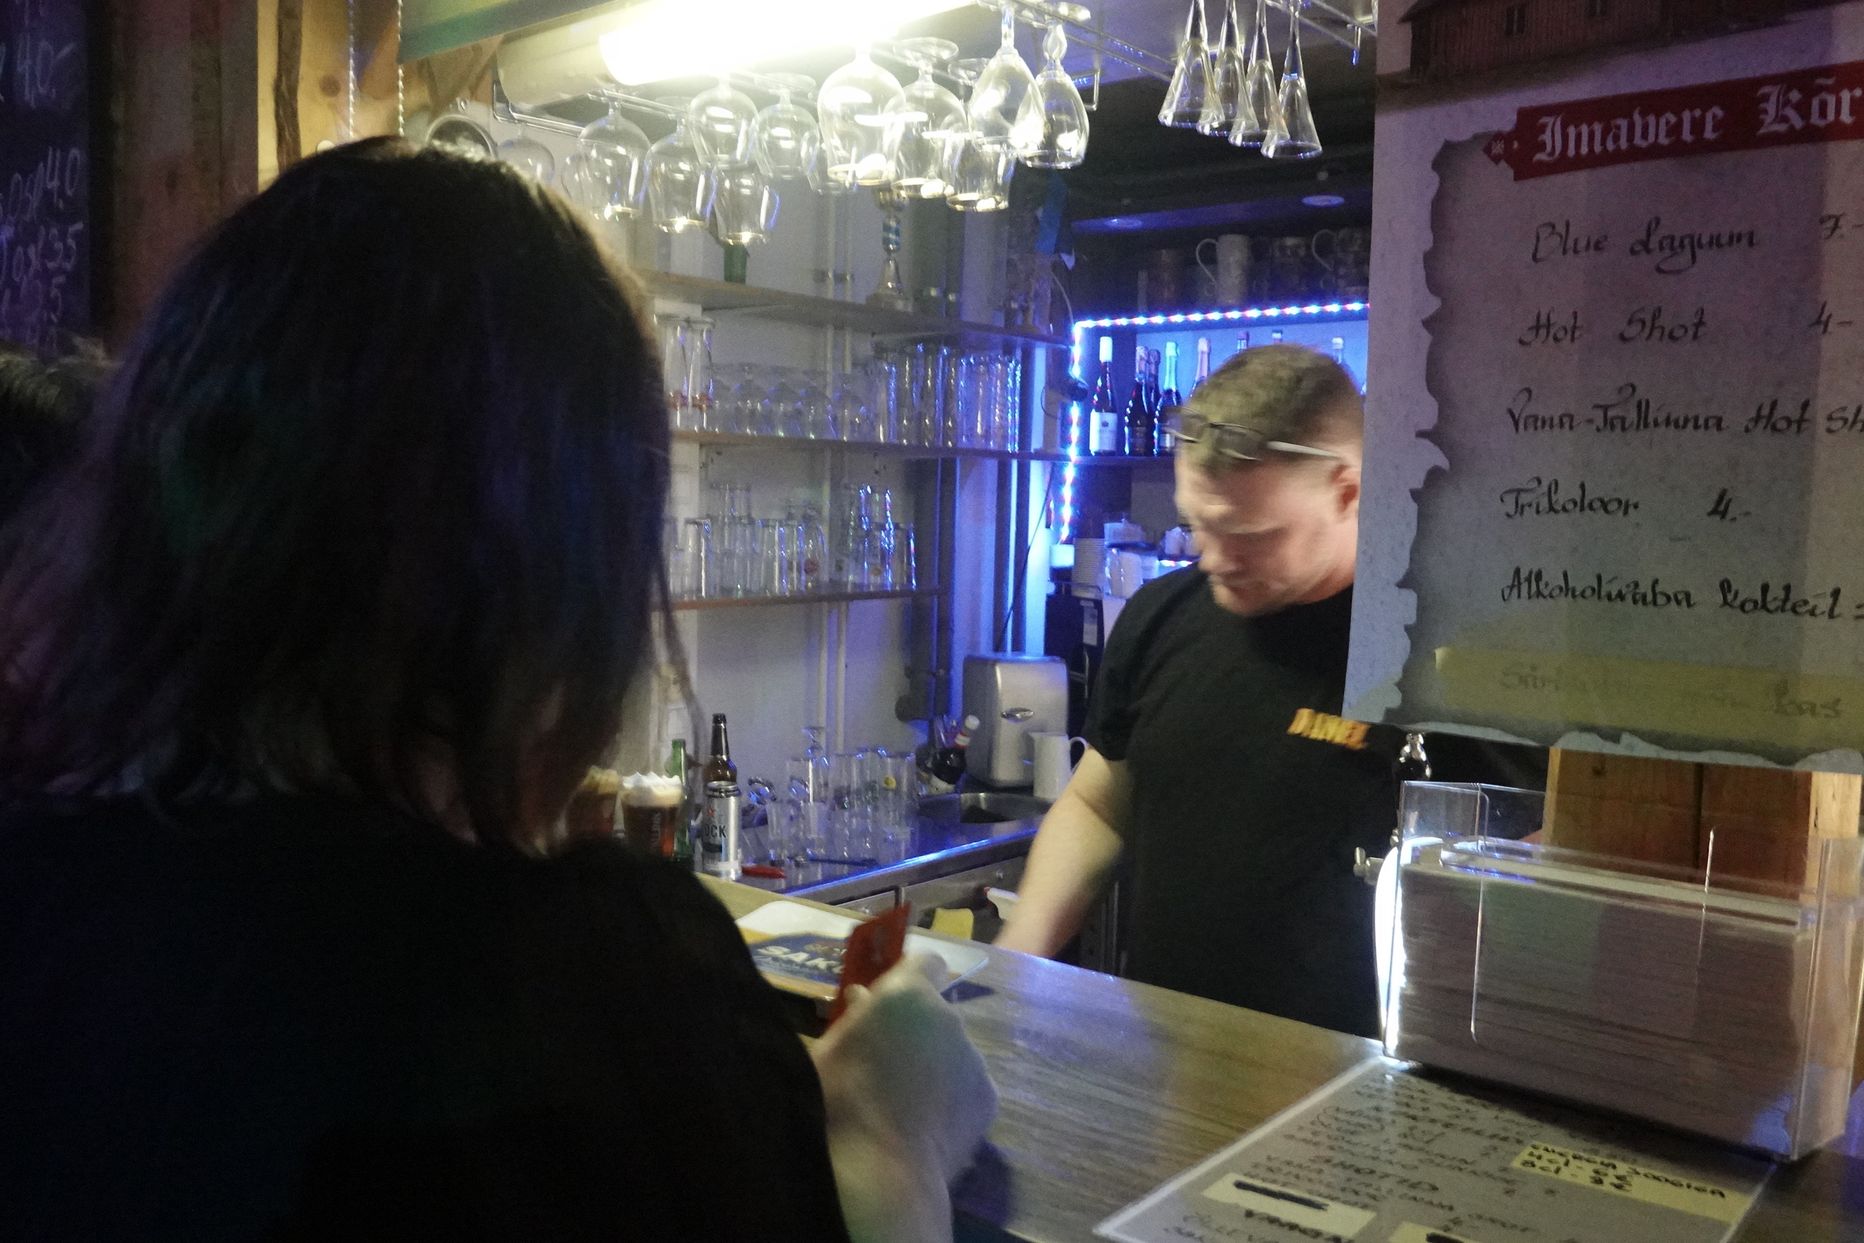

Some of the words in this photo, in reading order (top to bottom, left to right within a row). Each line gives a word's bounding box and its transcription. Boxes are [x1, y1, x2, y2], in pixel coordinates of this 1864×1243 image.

[1531, 106, 1725, 163] Imavere
[1531, 218, 1609, 264] Blue
[1517, 306, 1585, 347] Hot
[1618, 304, 1708, 343] Shot
[1744, 398, 1811, 435] Hot
